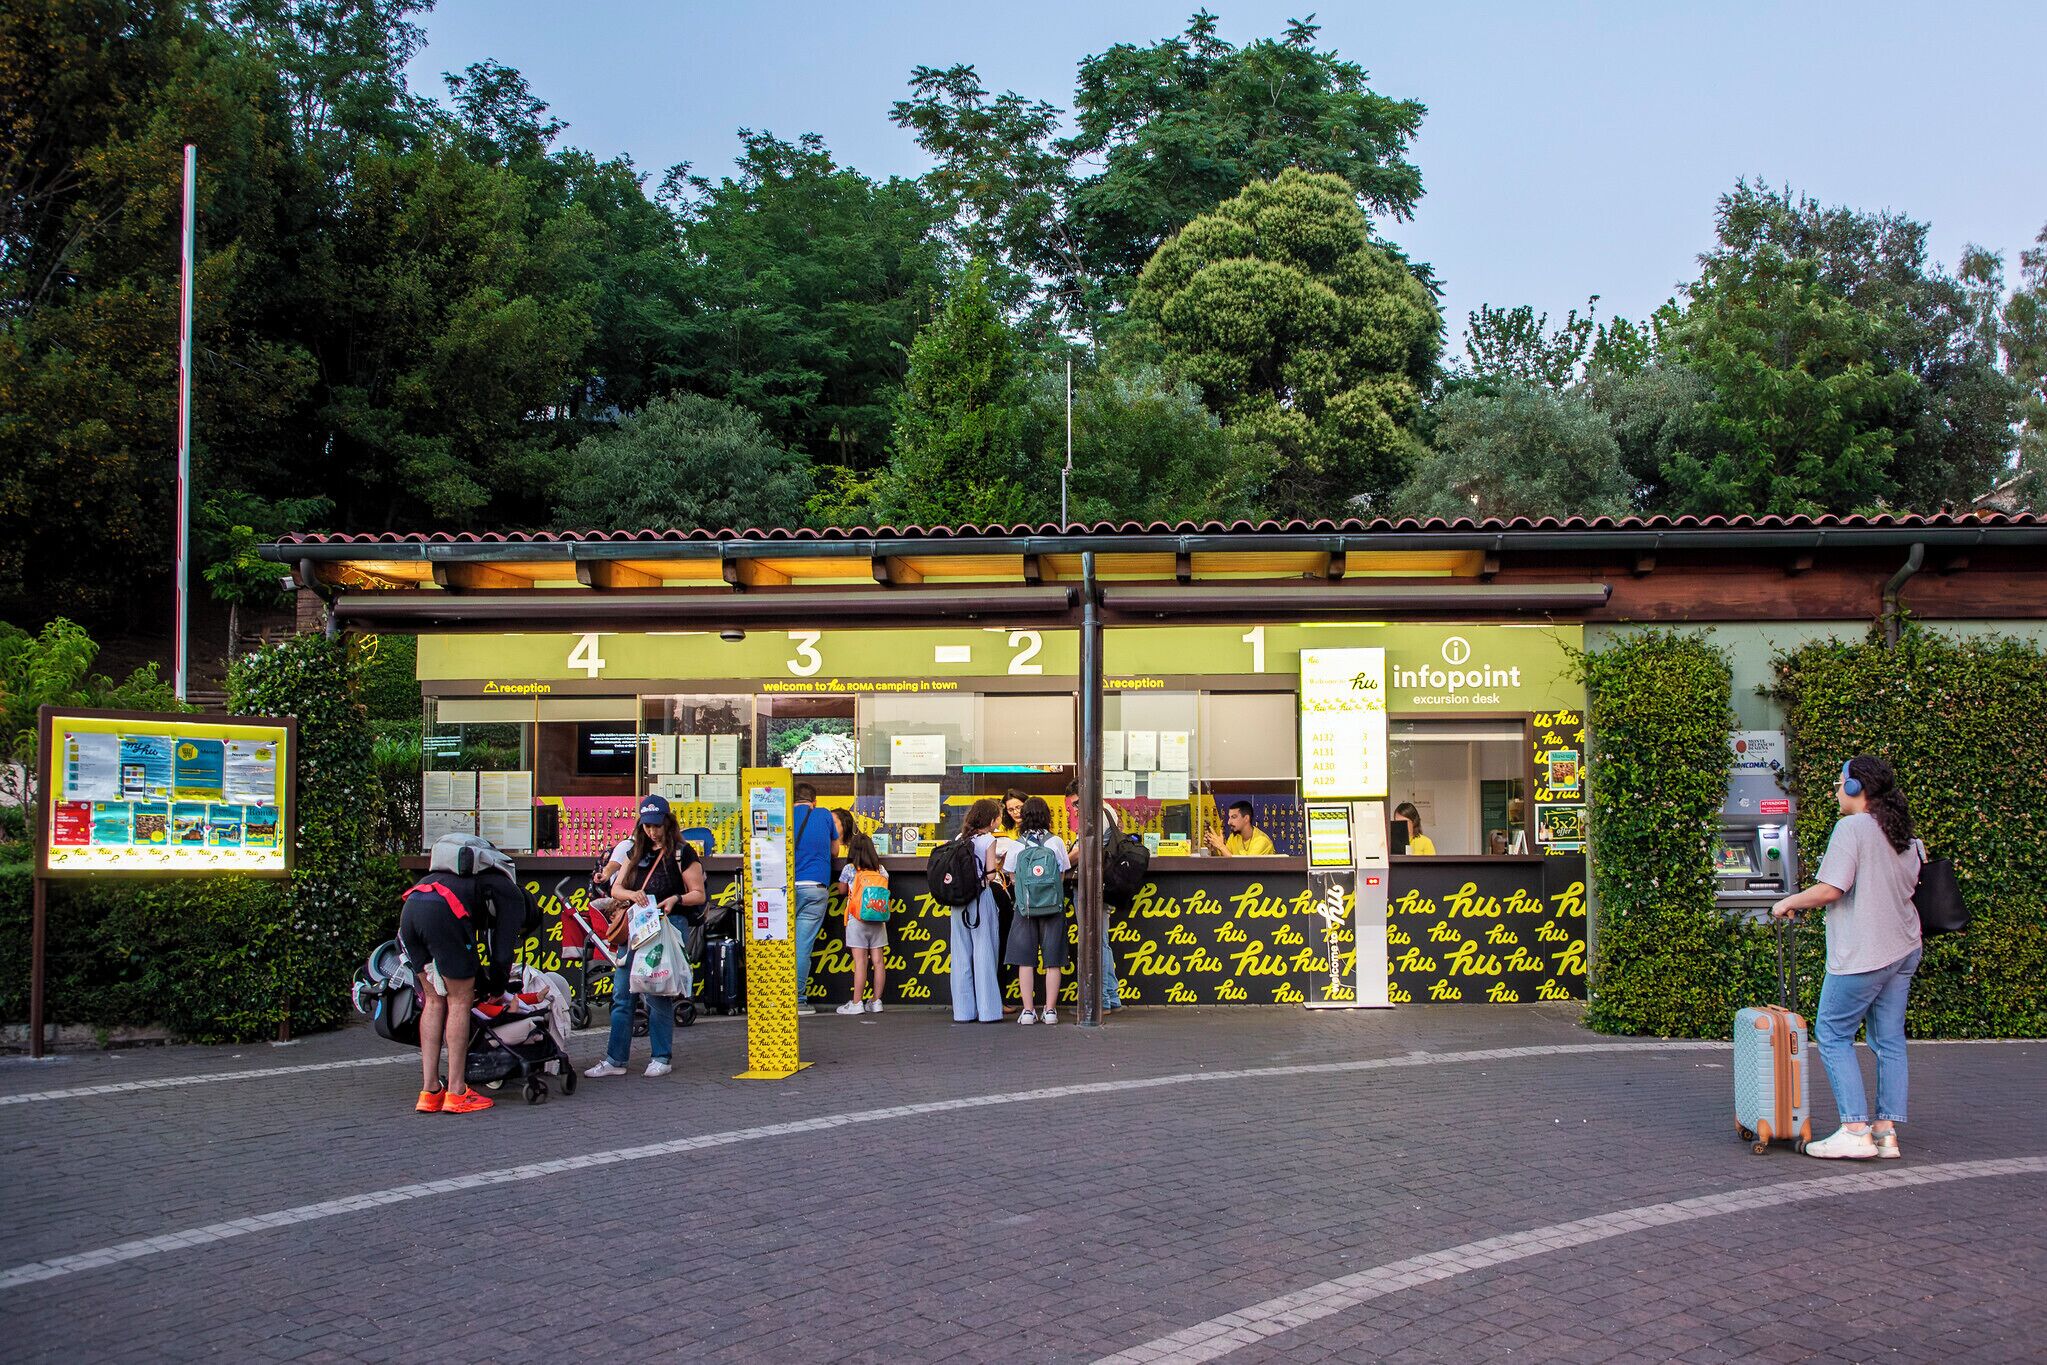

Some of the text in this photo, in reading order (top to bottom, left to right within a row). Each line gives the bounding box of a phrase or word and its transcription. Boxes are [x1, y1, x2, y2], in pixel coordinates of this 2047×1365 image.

[568, 634, 605, 678] 4
[786, 631, 823, 677] 3
[1007, 631, 1043, 675] 2
[1242, 626, 1265, 673] 1
[763, 679, 957, 693] welcome to hu ROMA camping in town
[1110, 677, 1164, 690] reception
[1349, 672, 1379, 690] hu
[1393, 664, 1520, 693] infopoint
[500, 682, 551, 695] reception
[1413, 693, 1500, 704] excursion desk
[1533, 709, 1579, 728] u hu
[1542, 731, 1563, 744] hu
[1312, 747, 1334, 756] A131
[1313, 762, 1335, 771] A130
[1313, 776, 1335, 785] A129
[1535, 787, 1554, 801] u
[1551, 816, 1578, 829] 3x2
[1129, 884, 1180, 918] hu
[1183, 890, 1222, 914] hu
[1230, 883, 1287, 918] hu
[1396, 889, 1436, 914] hu
[1443, 882, 1500, 918] hu
[1503, 889, 1543, 913] hu
[899, 921, 930, 940] hu
[1108, 921, 1140, 942] hu
[1165, 924, 1197, 944] hu
[1214, 921, 1247, 942] hu
[1271, 924, 1303, 945] hu
[1427, 921, 1461, 942] hu
[1485, 924, 1518, 944] hu
[1536, 921, 1568, 941] hu
[1317, 885, 1345, 992] welcome to hu
[1123, 939, 1181, 975] hu
[1183, 947, 1222, 972] hu
[1229, 939, 1288, 976] hu
[1289, 947, 1329, 972] hu
[1396, 947, 1436, 972] hu
[1443, 939, 1503, 976] hu
[1504, 947, 1544, 971] hu
[899, 978, 930, 997] hu
[1165, 982, 1197, 1002] hu
[1216, 979, 1247, 1000] hu
[1273, 982, 1304, 1002] hu
[1428, 979, 1461, 1000] hu
[1488, 982, 1518, 1002] hu
[1536, 979, 1569, 1001] hu
